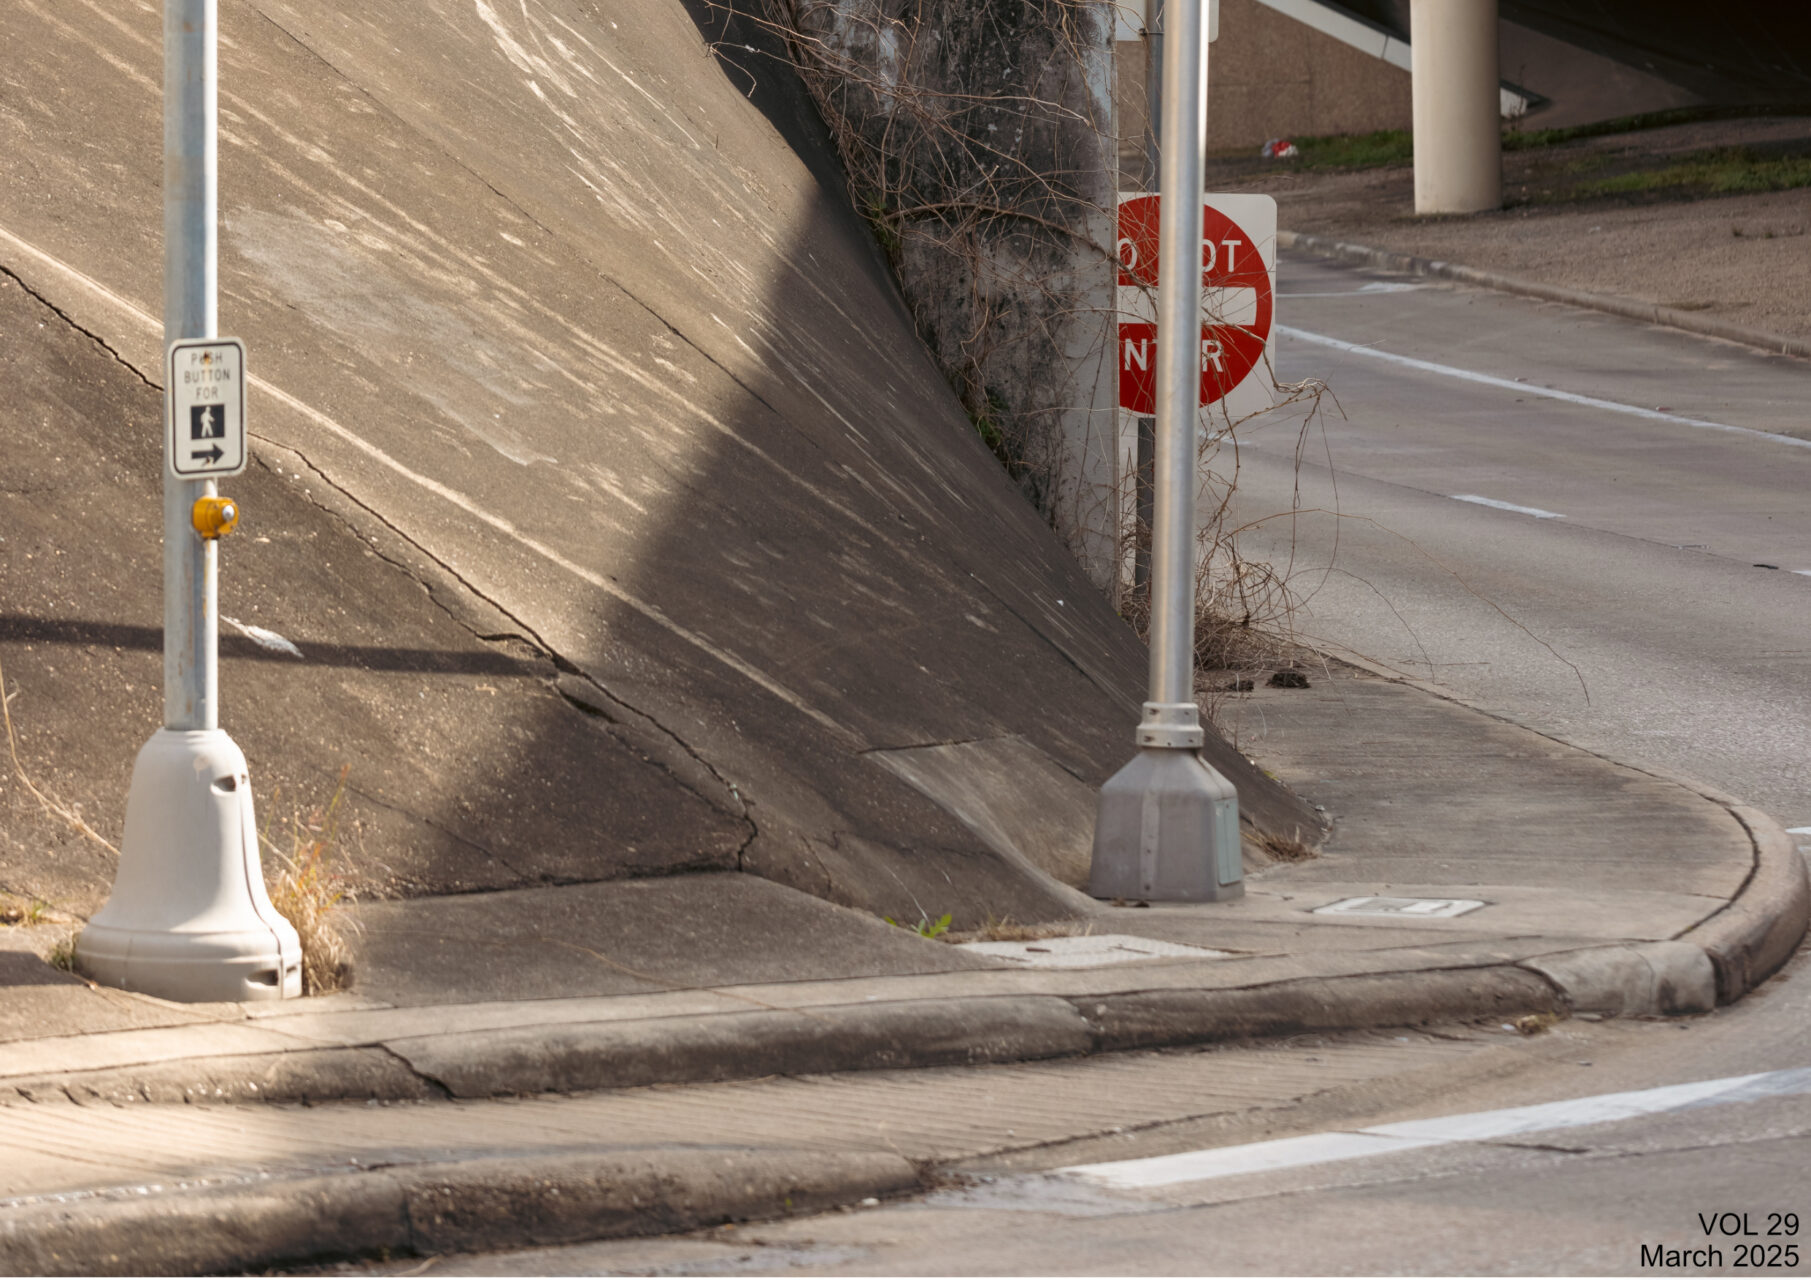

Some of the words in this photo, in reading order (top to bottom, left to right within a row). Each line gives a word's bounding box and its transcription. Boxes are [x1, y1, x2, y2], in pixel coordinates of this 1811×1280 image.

[1117, 237, 1139, 271] O
[1201, 238, 1242, 273] OT
[184, 368, 231, 384] BUTTON
[196, 386, 219, 400] FOR
